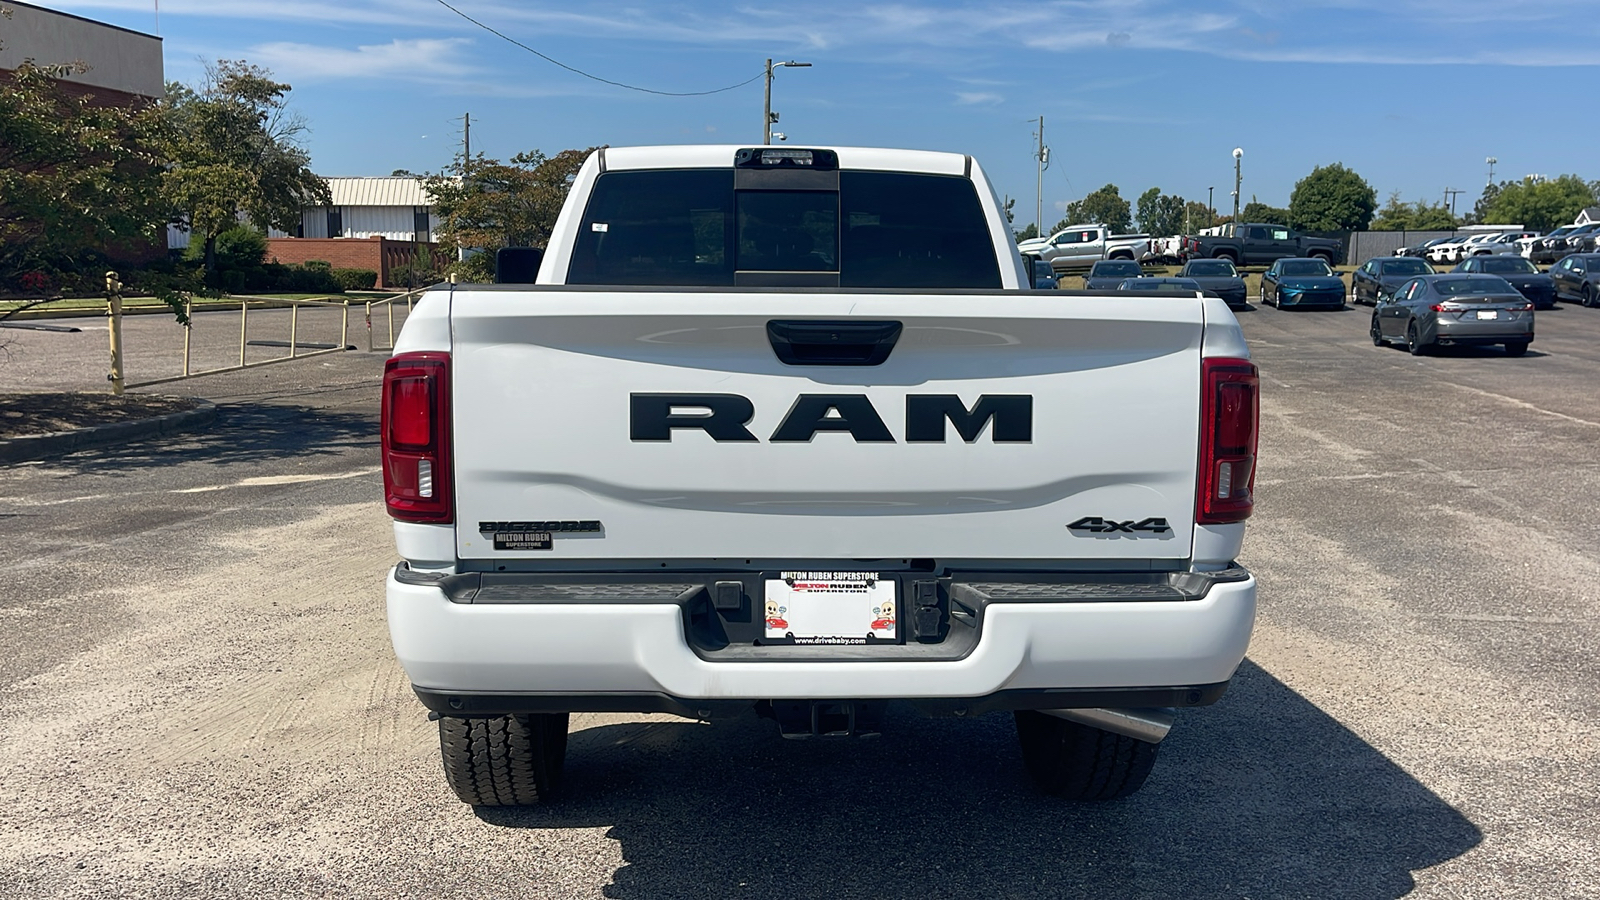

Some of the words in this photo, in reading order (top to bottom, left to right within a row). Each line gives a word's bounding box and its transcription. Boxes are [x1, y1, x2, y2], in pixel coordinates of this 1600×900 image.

[630, 393, 1033, 443] RAM
[1066, 517, 1170, 533] 4x4
[496, 533, 523, 542] MILTON
[524, 533, 550, 542] RUBEN
[781, 572, 807, 580] MILTON
[808, 572, 832, 580] RUBEN
[833, 572, 879, 580] SUPERSTORE
[795, 637, 866, 645] www.drivebaby.com
